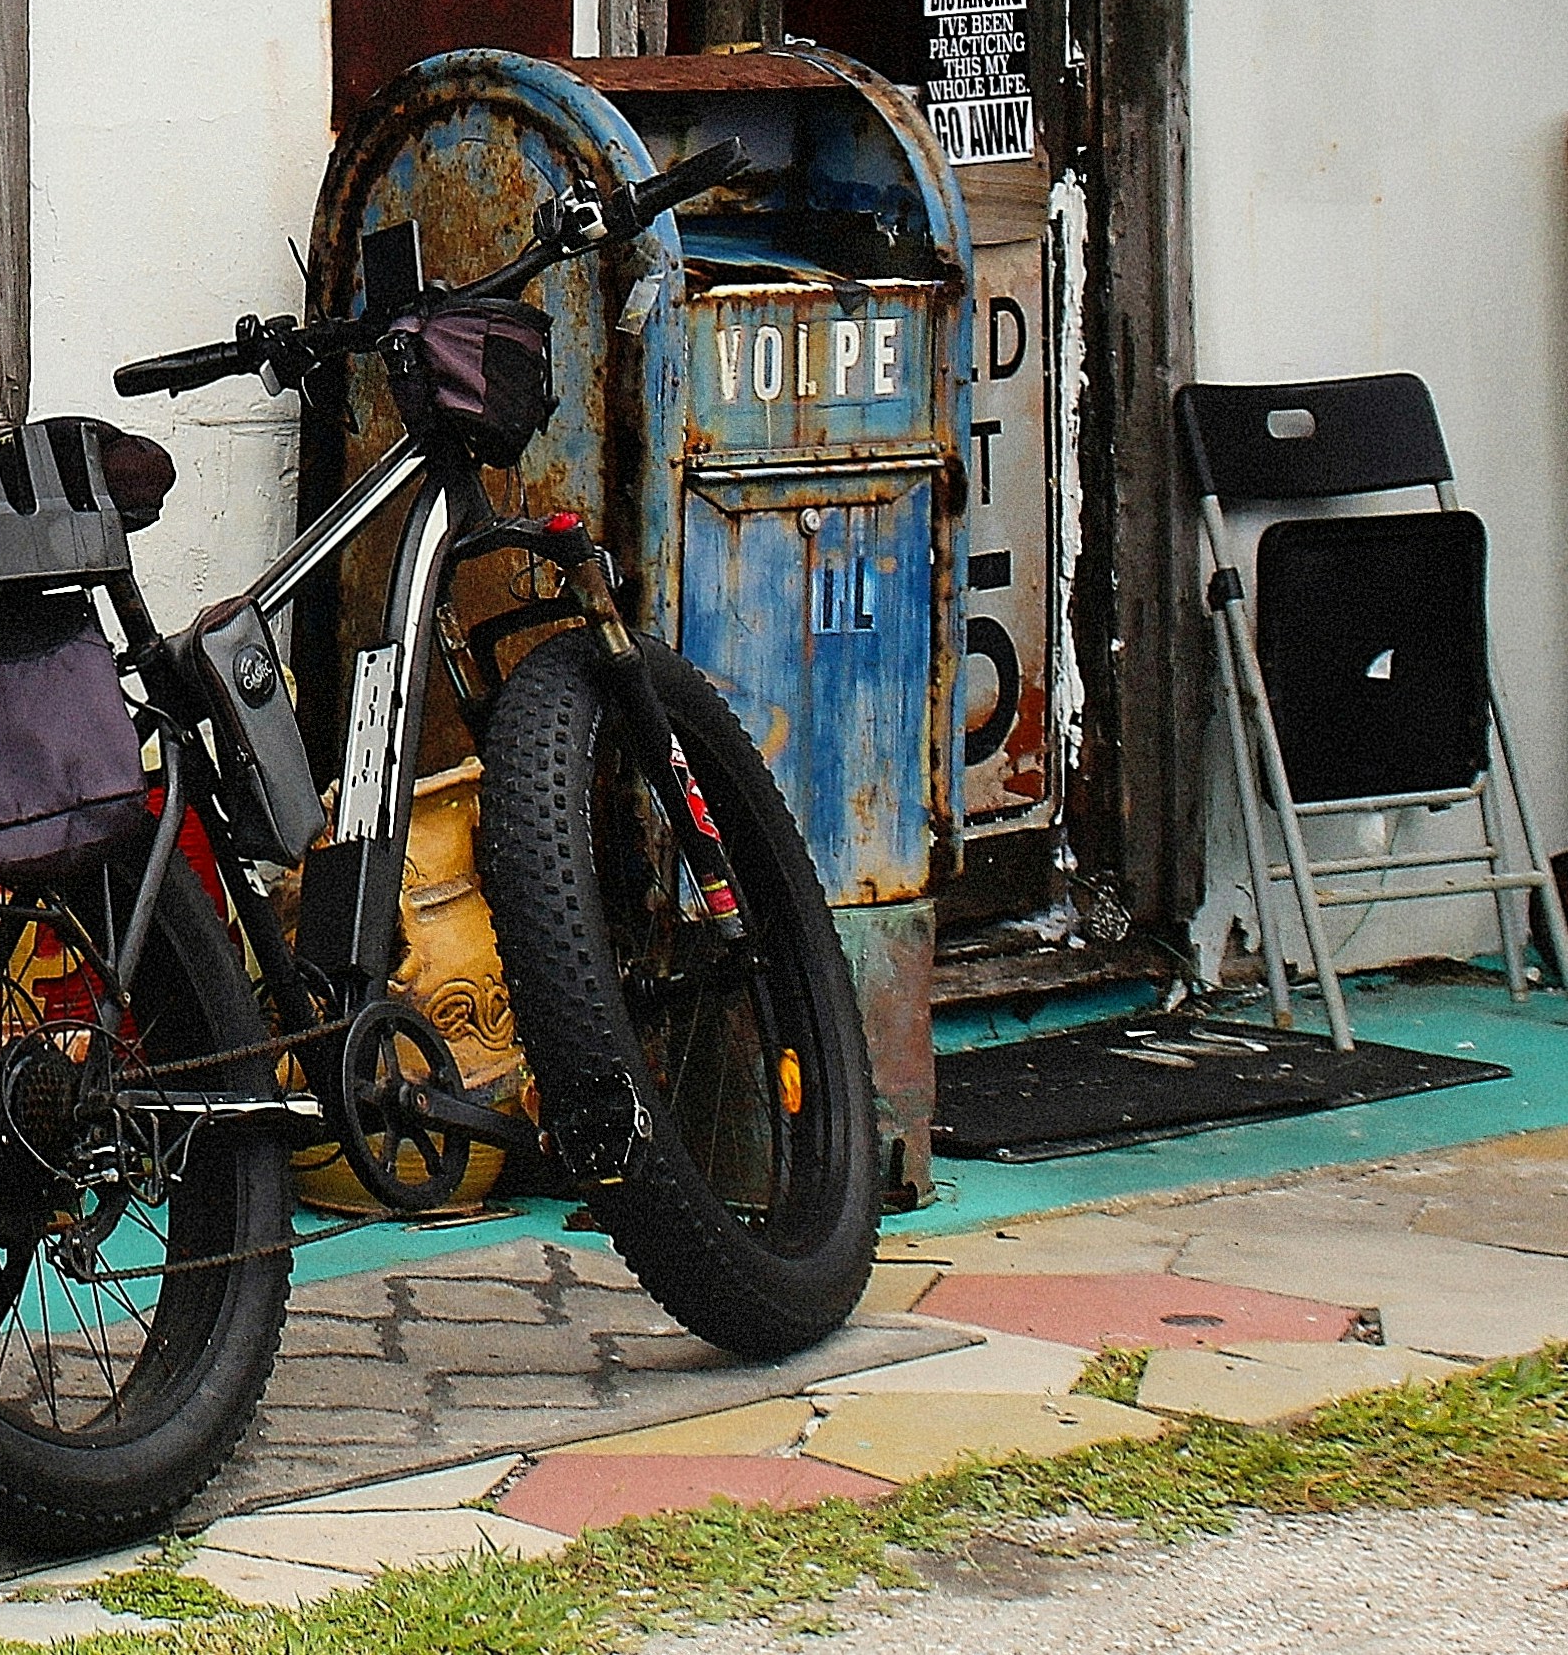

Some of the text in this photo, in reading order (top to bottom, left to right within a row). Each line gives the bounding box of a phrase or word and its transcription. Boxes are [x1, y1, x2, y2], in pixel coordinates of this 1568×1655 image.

[938, 12, 1015, 38] I'VE BEEN
[929, 32, 1026, 60] PRACTICING
[943, 54, 1011, 79] THIS MY
[926, 74, 1031, 102] WHOLE LIFE.
[933, 101, 1031, 161] GO AWAY
